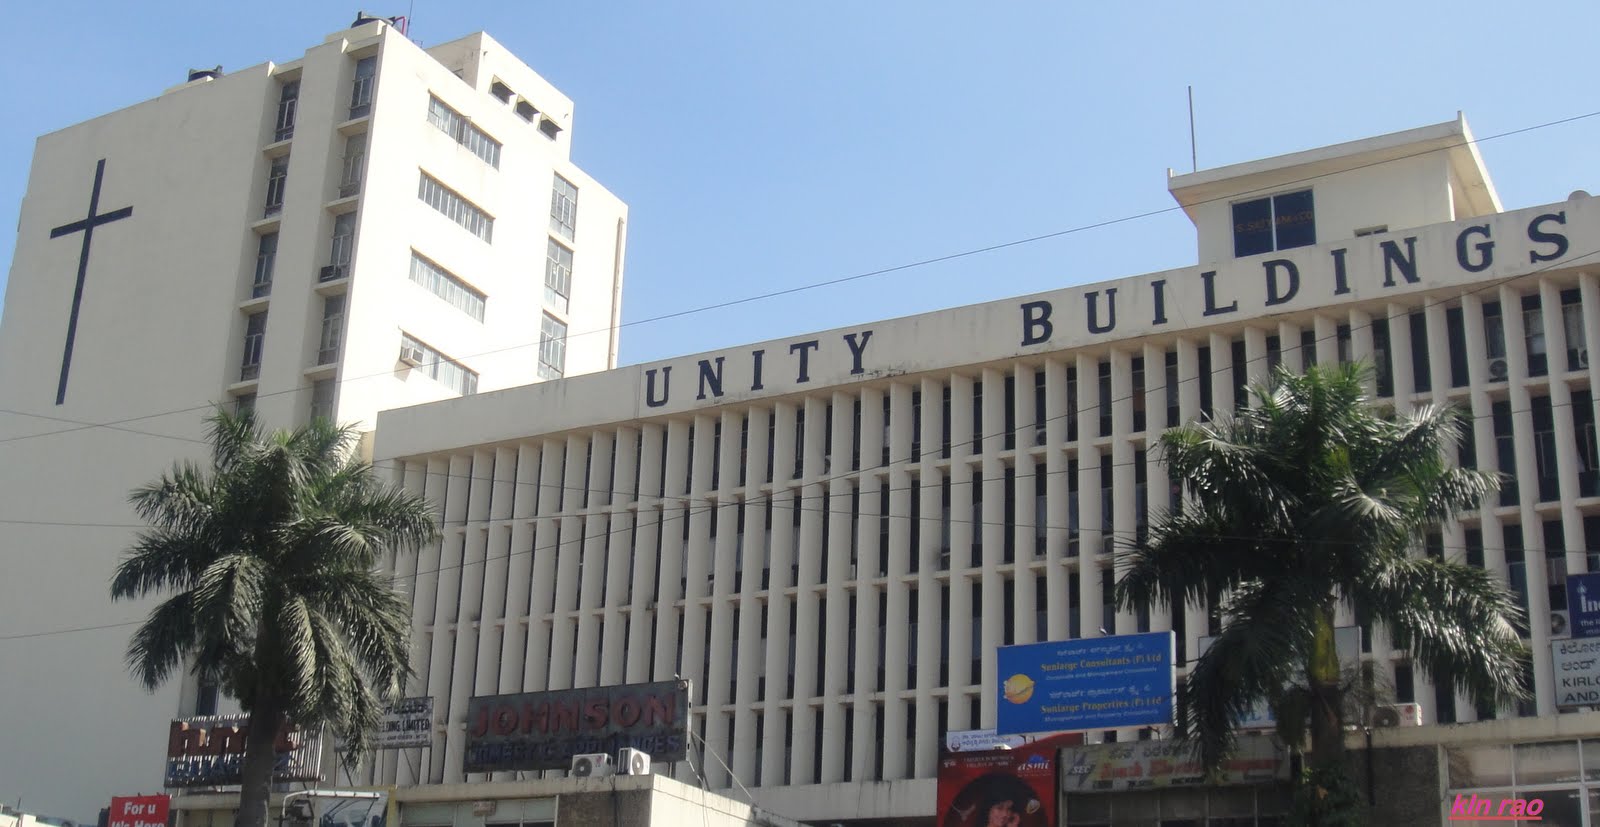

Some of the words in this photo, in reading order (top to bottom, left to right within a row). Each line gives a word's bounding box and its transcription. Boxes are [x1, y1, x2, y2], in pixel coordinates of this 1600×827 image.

[645, 330, 873, 408] UNITY
[1020, 211, 1569, 347] BUILDINGS
[1041, 663, 1077, 673] Sunlarge
[1080, 657, 1130, 668] Consultants
[1147, 654, 1161, 663] Ltd
[1041, 704, 1079, 714] Sunlarge
[1082, 700, 1128, 711] Properties
[1146, 696, 1161, 705] Ltd
[470, 694, 677, 738] JOHNSON
[402, 718, 430, 731] LIMITED
[1018, 760, 1050, 771] asmi
[1073, 765, 1091, 774] SEC
[124, 801, 145, 815] For
[148, 804, 156, 815] u
